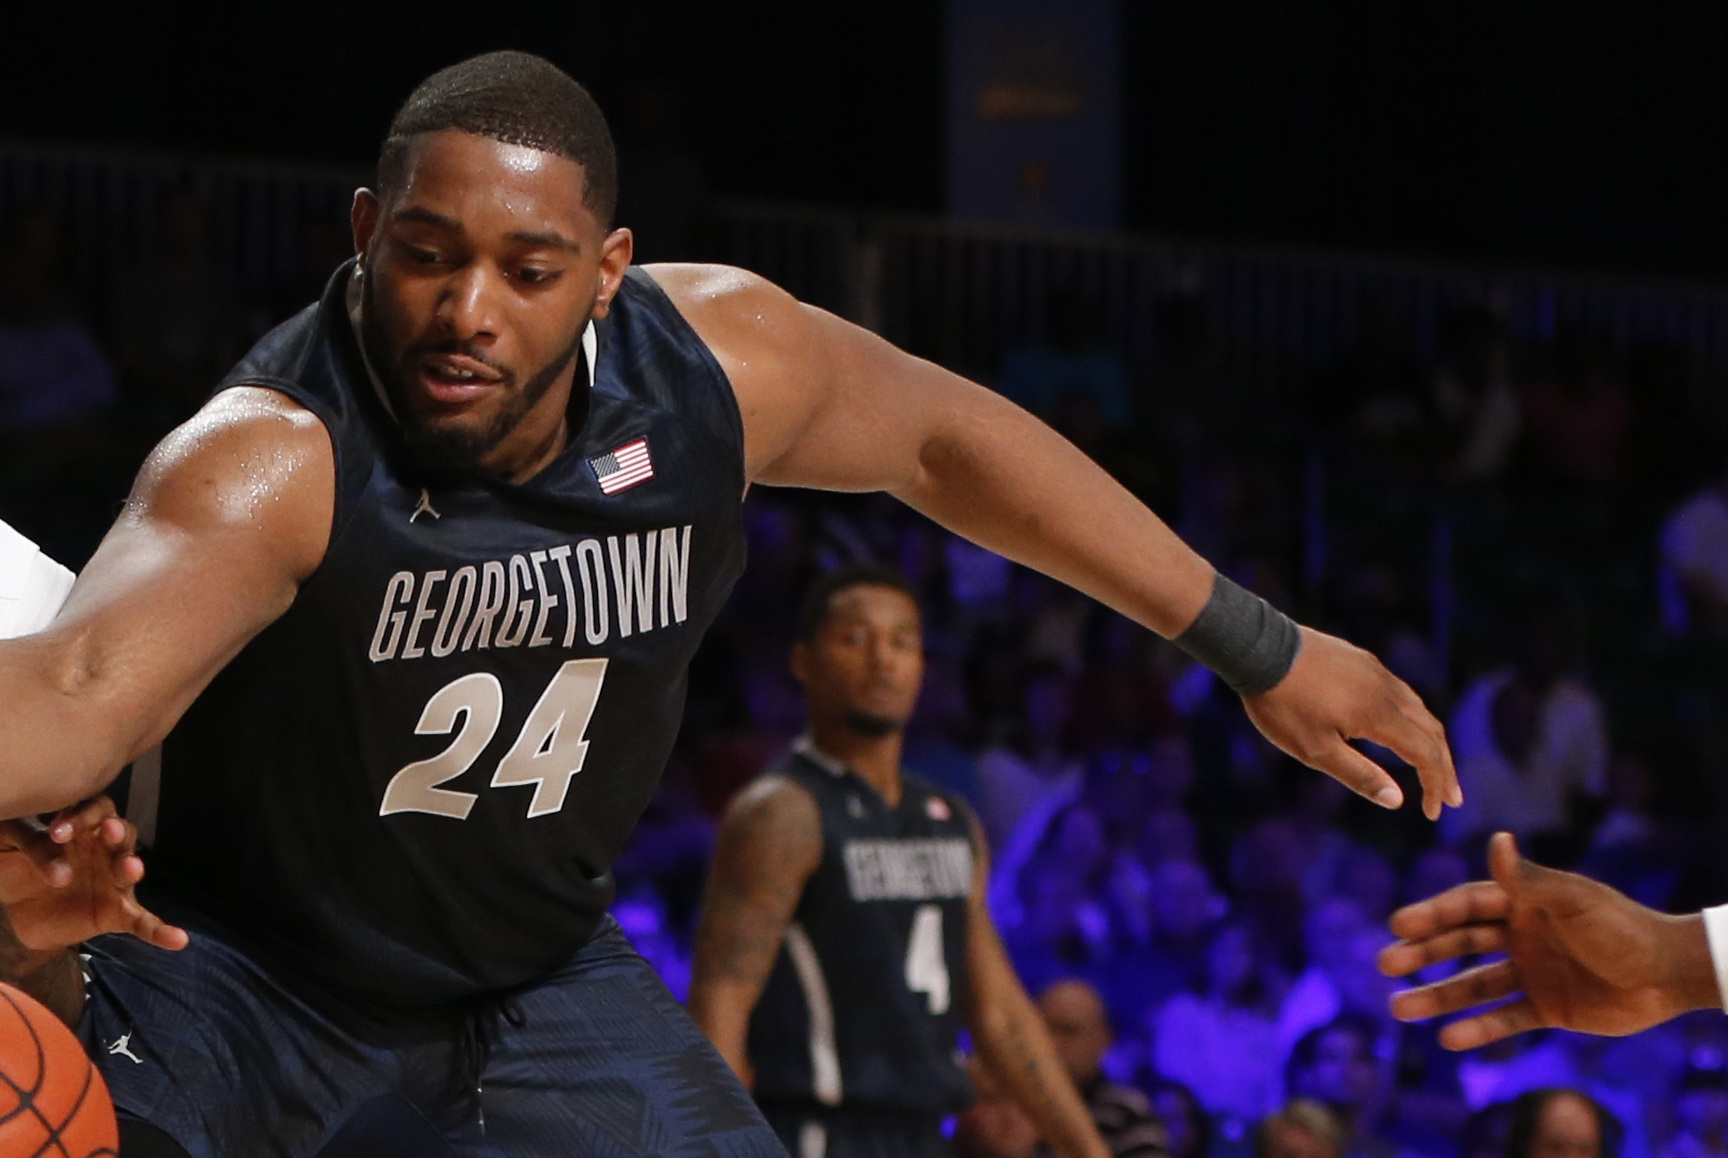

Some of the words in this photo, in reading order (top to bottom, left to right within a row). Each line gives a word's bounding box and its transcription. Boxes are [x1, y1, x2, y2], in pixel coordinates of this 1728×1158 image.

[368, 524, 693, 664] GEORGETOWN
[378, 657, 610, 821] 24
[904, 903, 952, 1016] 4
